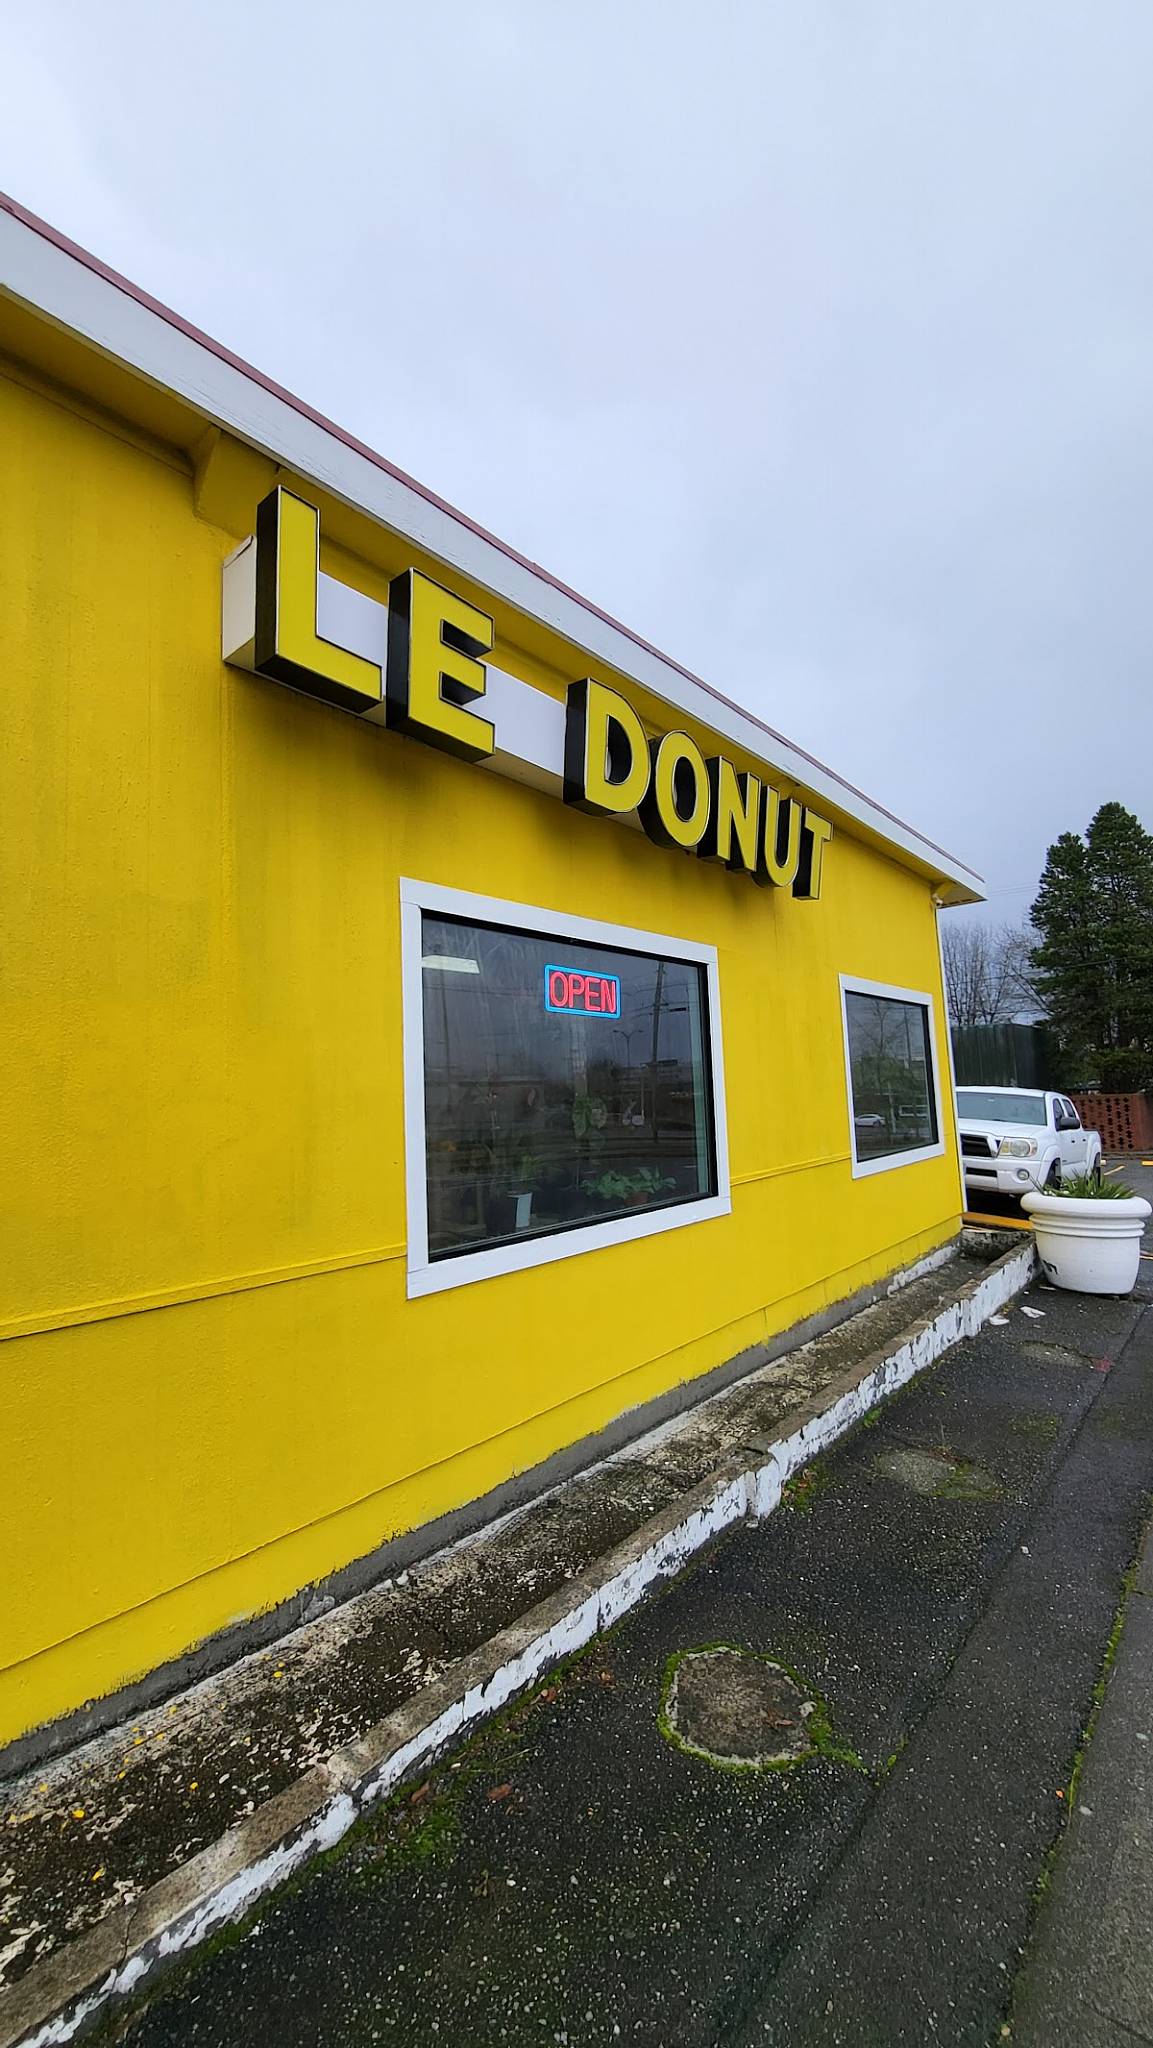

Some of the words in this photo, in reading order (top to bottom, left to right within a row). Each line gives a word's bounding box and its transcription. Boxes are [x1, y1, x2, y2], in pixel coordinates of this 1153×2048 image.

[259, 485, 496, 761] LE
[566, 678, 833, 900] DONUT
[550, 971, 616, 1013] OPEN
